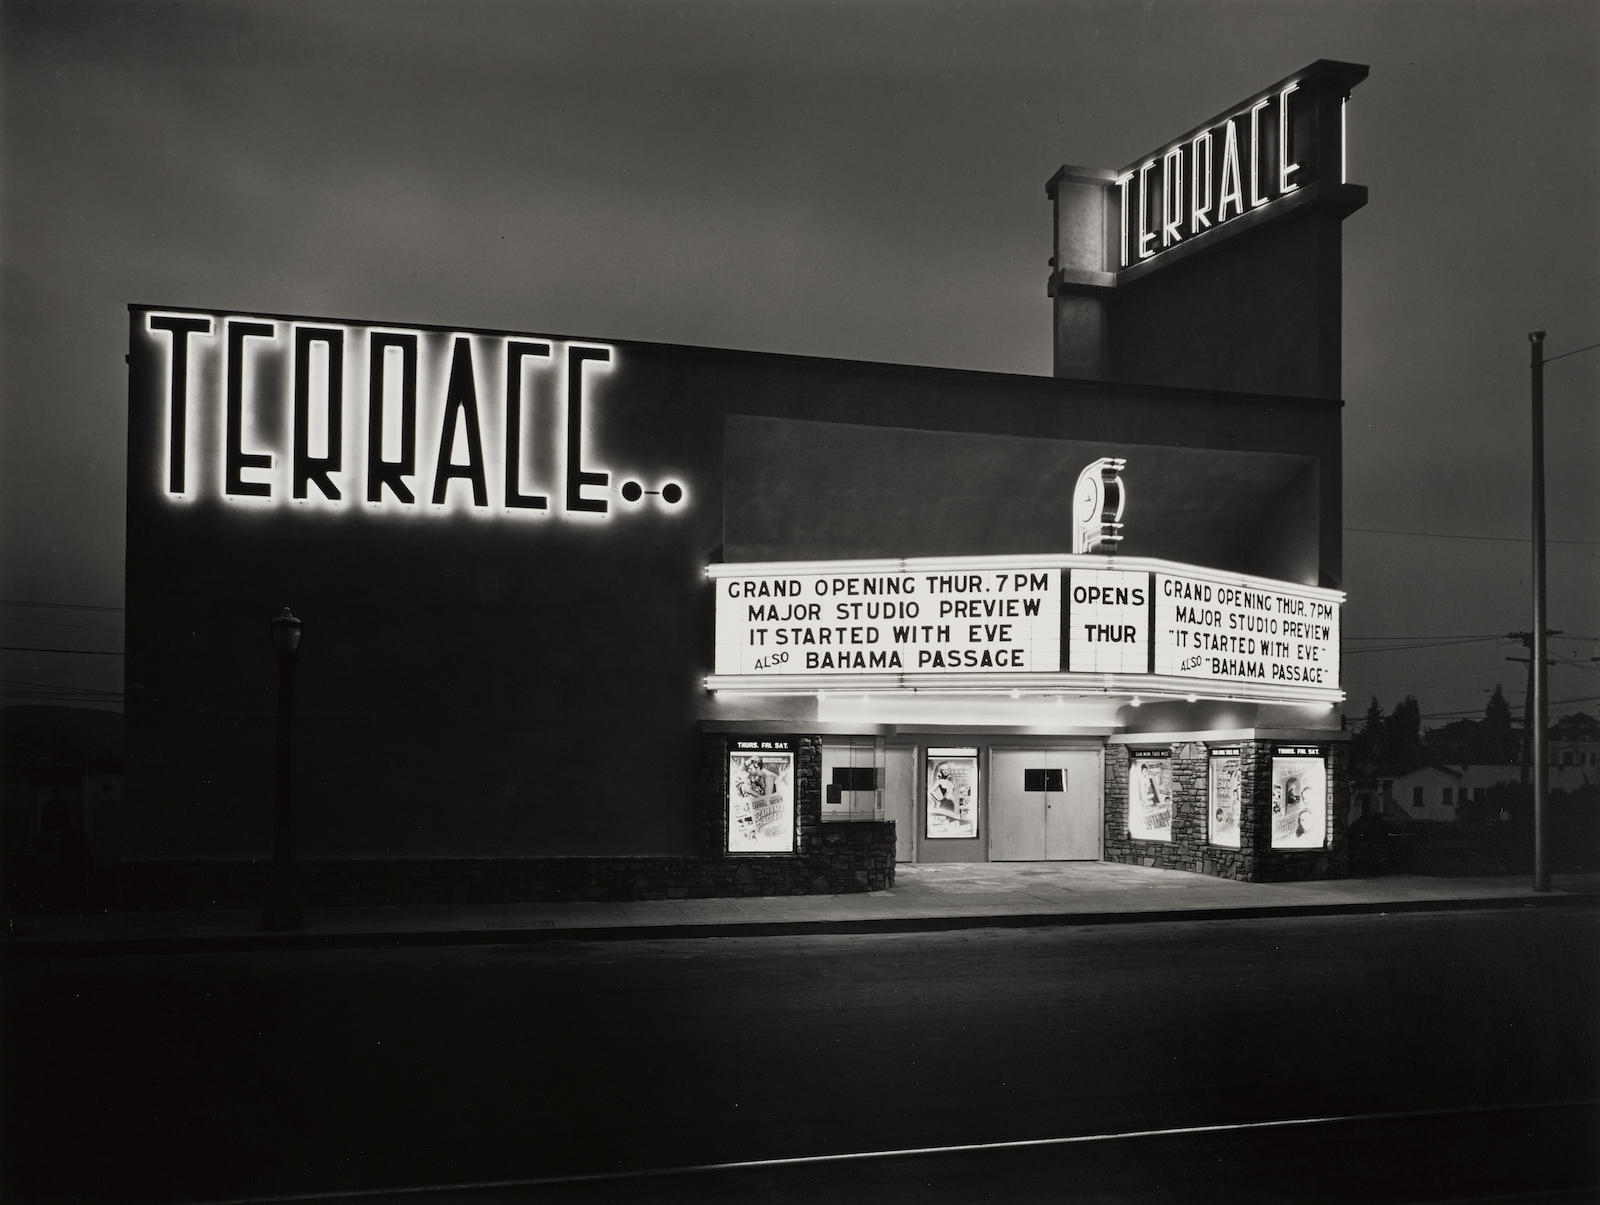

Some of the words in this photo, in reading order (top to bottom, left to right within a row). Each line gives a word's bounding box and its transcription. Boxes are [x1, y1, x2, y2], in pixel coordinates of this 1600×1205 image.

[1115, 81, 1299, 266] TERRACE
[148, 316, 611, 513] TERRACE
[728, 580, 801, 598] GRAND
[815, 577, 916, 596] OPENING
[926, 575, 990, 593] THUR.
[1073, 586, 1145, 606] OPENS
[1164, 580, 1212, 603] GRAND
[1217, 588, 1272, 612] OPENING
[1276, 597, 1308, 617] THUR.
[748, 604, 821, 622] MAJOR
[836, 602, 920, 620] STUDIO
[939, 599, 1041, 618] PREVIEW
[1085, 624, 1137, 643] THUR
[1176, 605, 1223, 628] MAJOR
[1229, 613, 1278, 635] STUDIO
[1283, 621, 1331, 641] PREVIEW
[749, 629, 767, 646] IT
[776, 626, 880, 645] STARTED
[893, 626, 950, 643] WITH
[969, 625, 1013, 642] EVE
[1193, 632, 1256, 655] STARTED
[1260, 641, 1290, 659] WITH
[754, 651, 790, 670] ALSO
[806, 651, 903, 669] BAHAMA
[918, 649, 1025, 667] PASSAGE
[1180, 654, 1203, 673] ALSO
